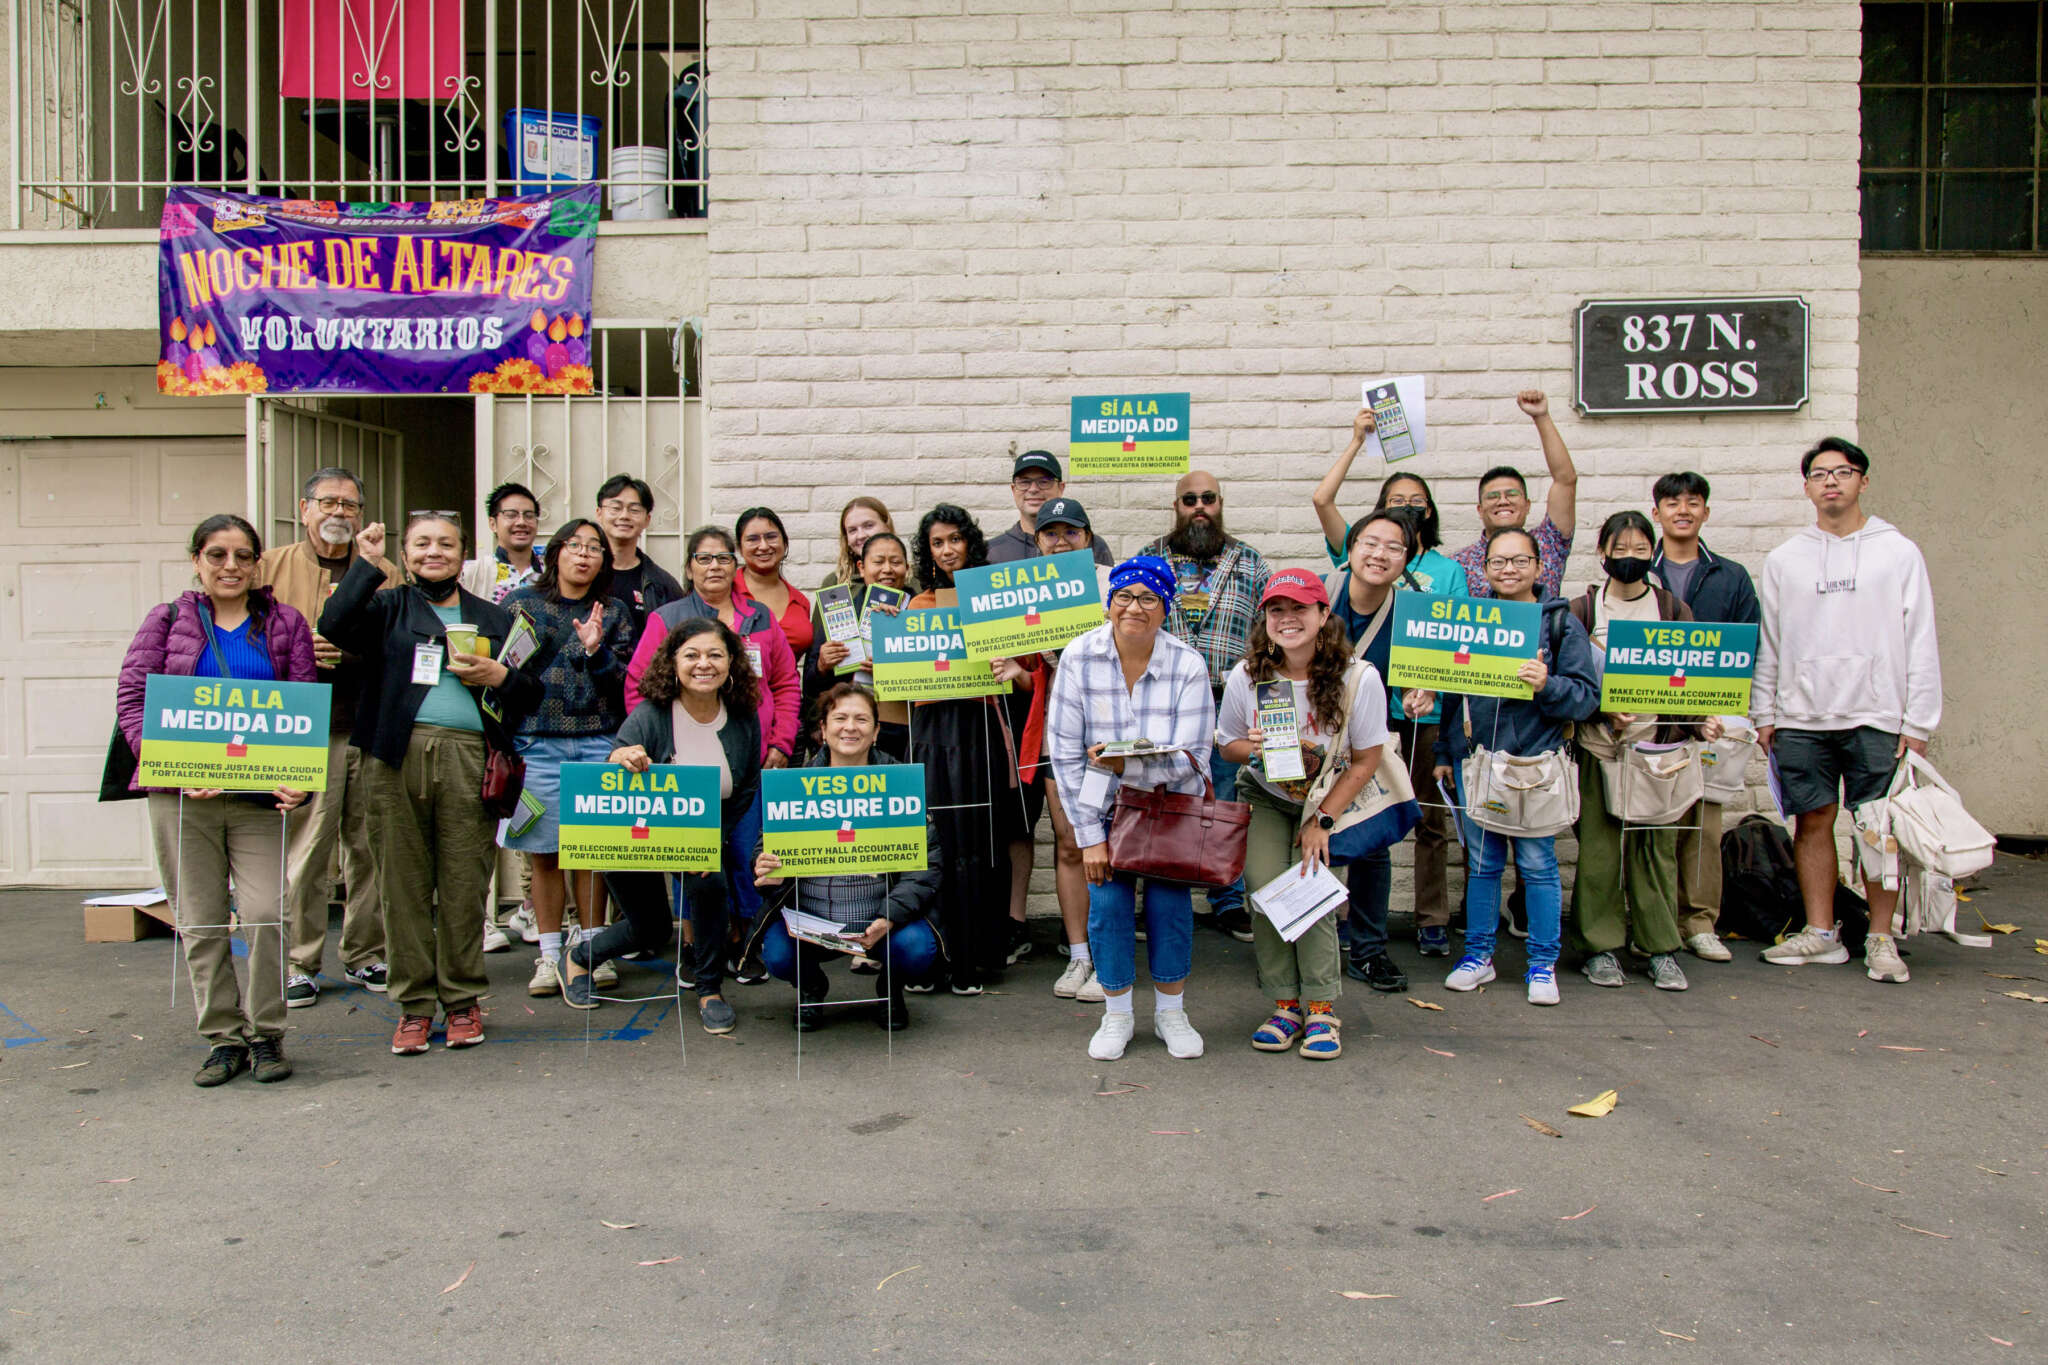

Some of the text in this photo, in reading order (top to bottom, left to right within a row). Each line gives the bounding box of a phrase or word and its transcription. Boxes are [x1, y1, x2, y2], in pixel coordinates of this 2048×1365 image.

[180, 235, 573, 308] NOCHE DE ALTARES
[240, 316, 503, 351] VOLUNTARIOS
[1623, 313, 1756, 352] 837 N.
[1624, 360, 1758, 400] ROSS
[1100, 399, 1158, 416] SÍ A LA
[1081, 417, 1178, 434] MEDIDA DD
[990, 563, 1060, 588] SÍ A LA
[970, 579, 1085, 613] MEDIDA DD
[1431, 600, 1502, 624] SÍ A LA
[906, 613, 962, 632] SÍ A L
[982, 633, 1026, 645] ELECCIONES
[1027, 628, 1054, 638] JUSTAS
[1076, 621, 1102, 630] CIUDAD
[1406, 620, 1525, 647] MEDIDA DD
[1644, 628, 1721, 647] YES ON
[884, 634, 964, 653] MEDIDA
[975, 643, 1015, 653] FORTALECE
[1016, 637, 1048, 646] NUESTRA
[1610, 648, 1750, 668] MEASURE DD
[1398, 672, 1524, 690] FORTALECE NUESTRA DEMOCRACIA
[1408, 666, 1450, 674] ELECCIONES
[1452, 670, 1480, 678] JUSTAS
[194, 684, 284, 710] SÍ A LA
[1609, 696, 1666, 704] STRENGTHEN
[1687, 699, 1741, 707] DEMOCRACY
[1680, 690, 1743, 698] ACCOUNTABLE
[160, 708, 312, 734] MEDIDA DD
[152, 769, 313, 782] FORTALECE NUESTRA DEMOCRACIA
[164, 761, 222, 771] ELECCIONES
[224, 764, 260, 772] JUSTAS
[290, 766, 324, 774] CIUDAD
[601, 769, 679, 792] SÍ A LA
[801, 774, 886, 796] YES ON
[575, 795, 705, 816] MEDIDA DD
[767, 796, 921, 820] MEASURE DD
[656, 854, 709, 862] DEMOCRACIA
[772, 843, 920, 856] MAKE CITY HALL ACCOUNTABLE
[781, 856, 836, 866] TRENGTHEN
[860, 853, 918, 862] DEMOCRACY
